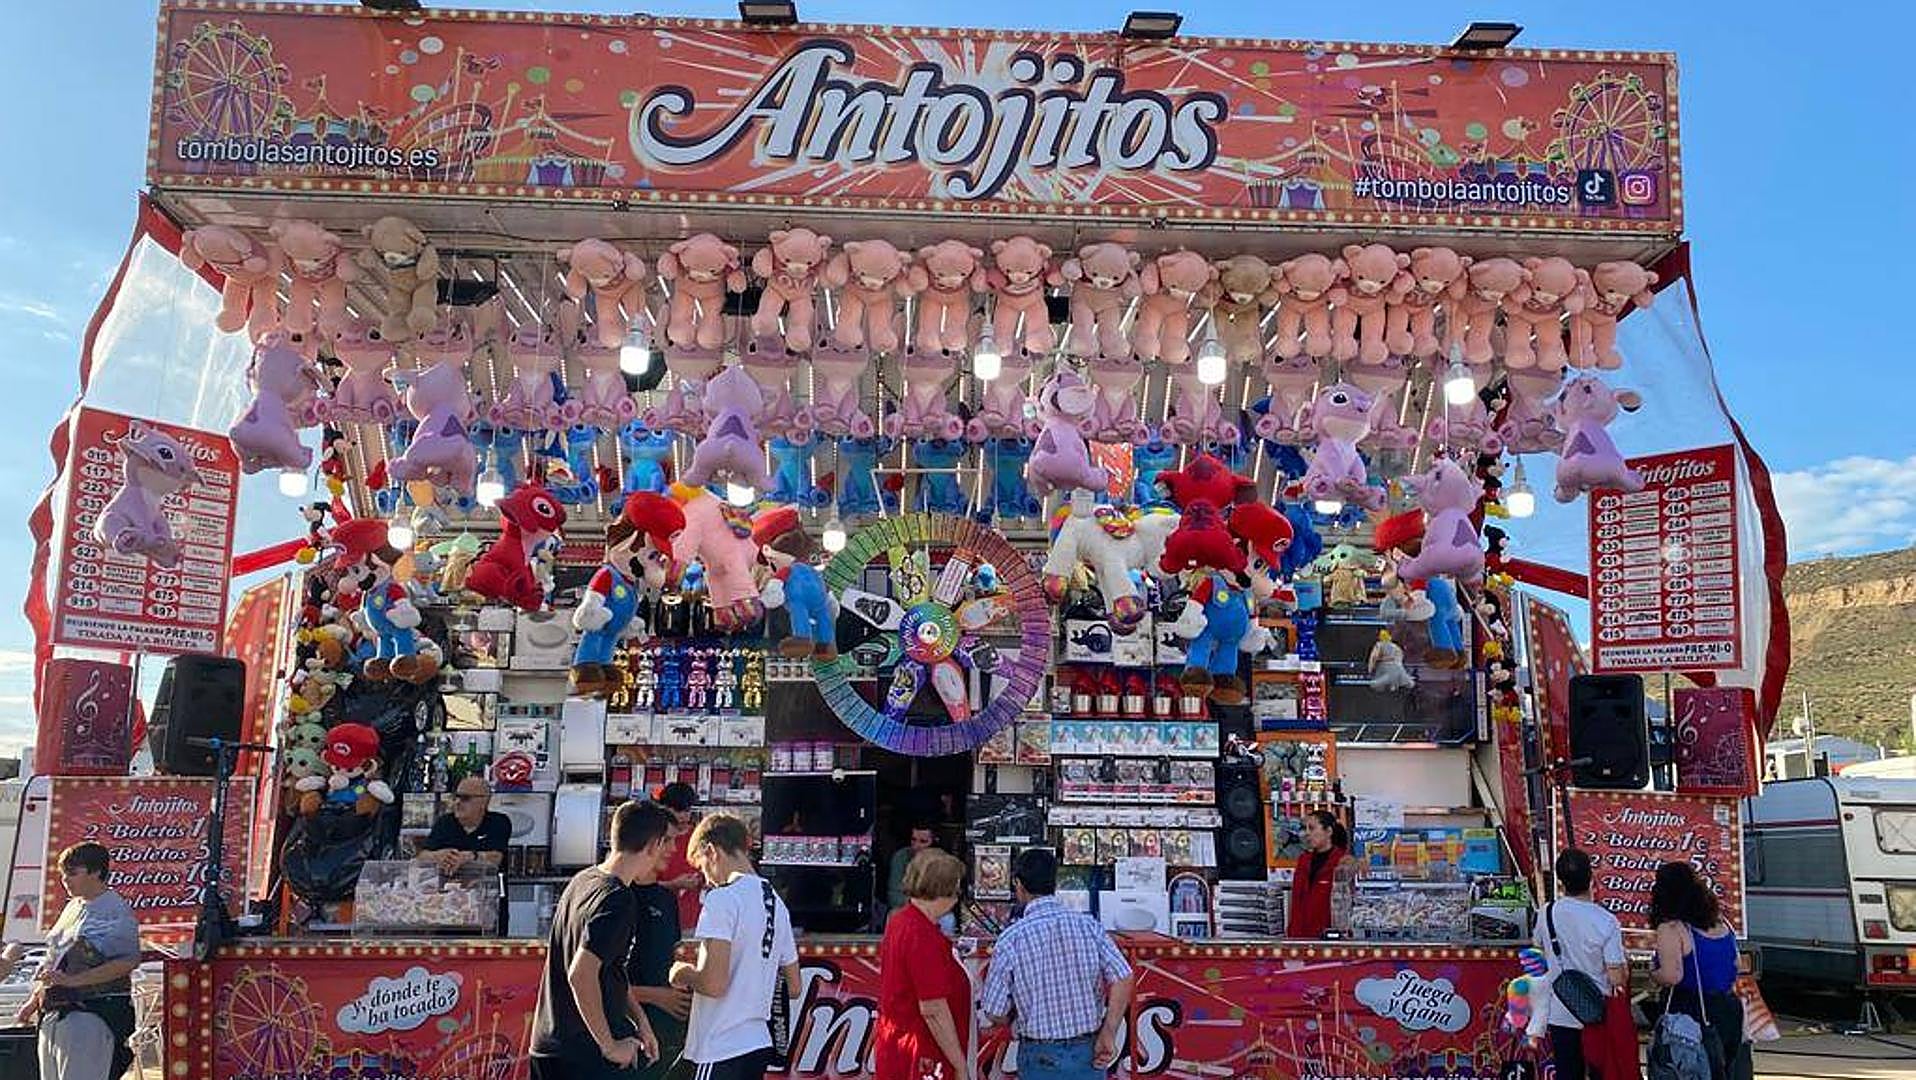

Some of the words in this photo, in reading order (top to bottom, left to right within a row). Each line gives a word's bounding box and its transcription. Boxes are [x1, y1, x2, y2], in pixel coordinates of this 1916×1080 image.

[639, 38, 1229, 199] Antojitos
[177, 138, 439, 168] tombolasantojitos.es
[1354, 176, 1570, 205] #tombolaantojitos
[109, 795, 199, 817] Antojitos
[1604, 807, 1686, 829] Antojitos
[84, 823, 100, 839] 2
[107, 824, 185, 839] Boletos
[1584, 832, 1597, 845] 2
[1602, 832, 1675, 850] Boletos
[109, 845, 188, 861] Boletos
[1606, 854, 1666, 870] Bolet
[107, 871, 180, 885] Boletos
[1601, 875, 1657, 891] Bolet
[128, 894, 177, 908] letos
[1602, 897, 1650, 914] Bole
[370, 981, 421, 1008] dónde
[426, 979, 440, 993] te
[1393, 973, 1454, 1007] Juega
[368, 1008, 389, 1026] ha
[394, 987, 456, 1019] tocado?
[1381, 998, 1399, 1015] y
[1402, 997, 1453, 1026] Gana
